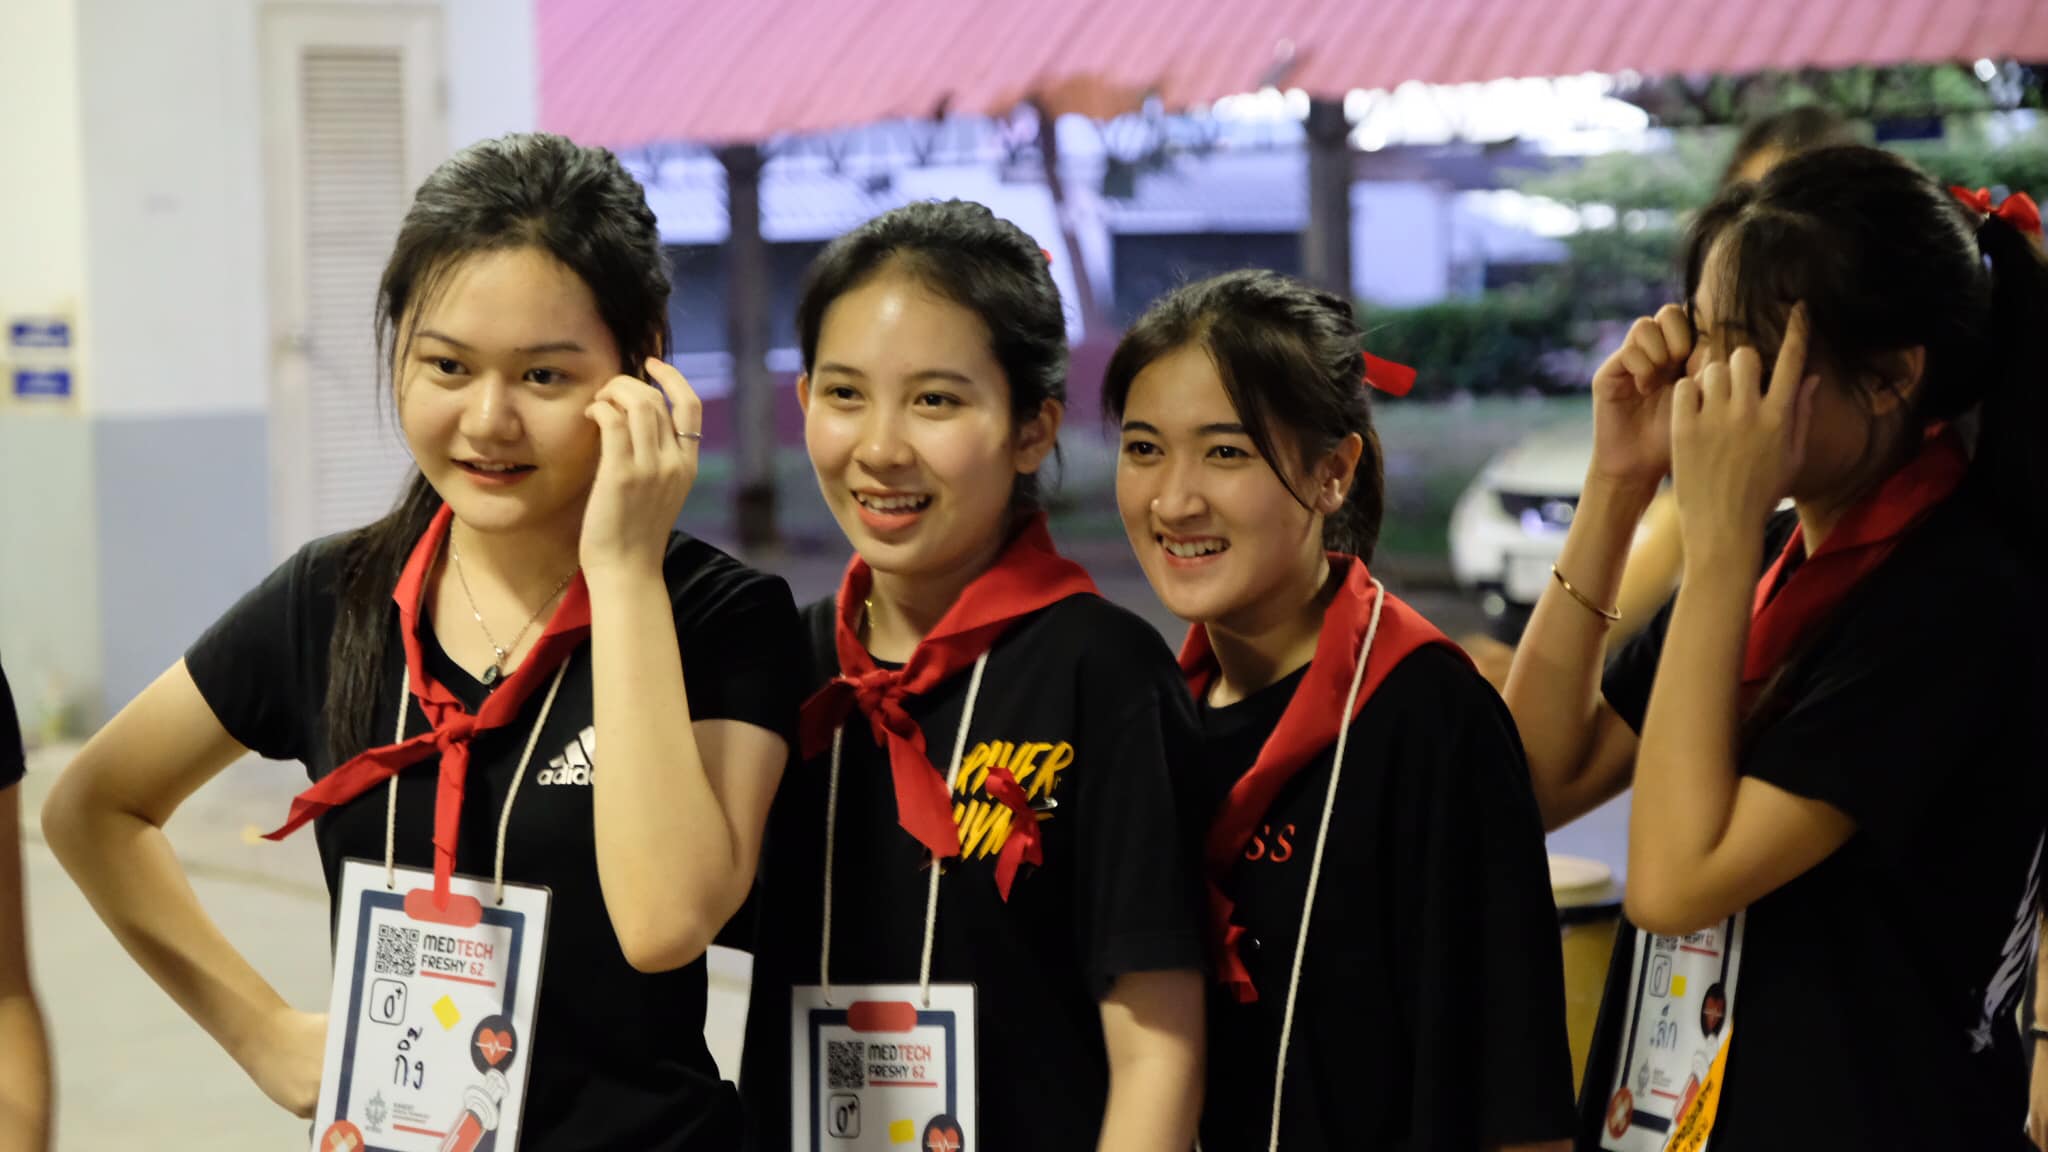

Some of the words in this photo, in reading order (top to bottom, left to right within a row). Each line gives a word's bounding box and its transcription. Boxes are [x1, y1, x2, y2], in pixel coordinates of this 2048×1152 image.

[423, 934, 494, 960] MEDTECH
[421, 954, 466, 974] FRESHY
[470, 962, 484, 976] 62
[868, 1044, 932, 1062] MEDTECH
[868, 1065, 909, 1079] FRESHY
[912, 1066, 926, 1079] 62
